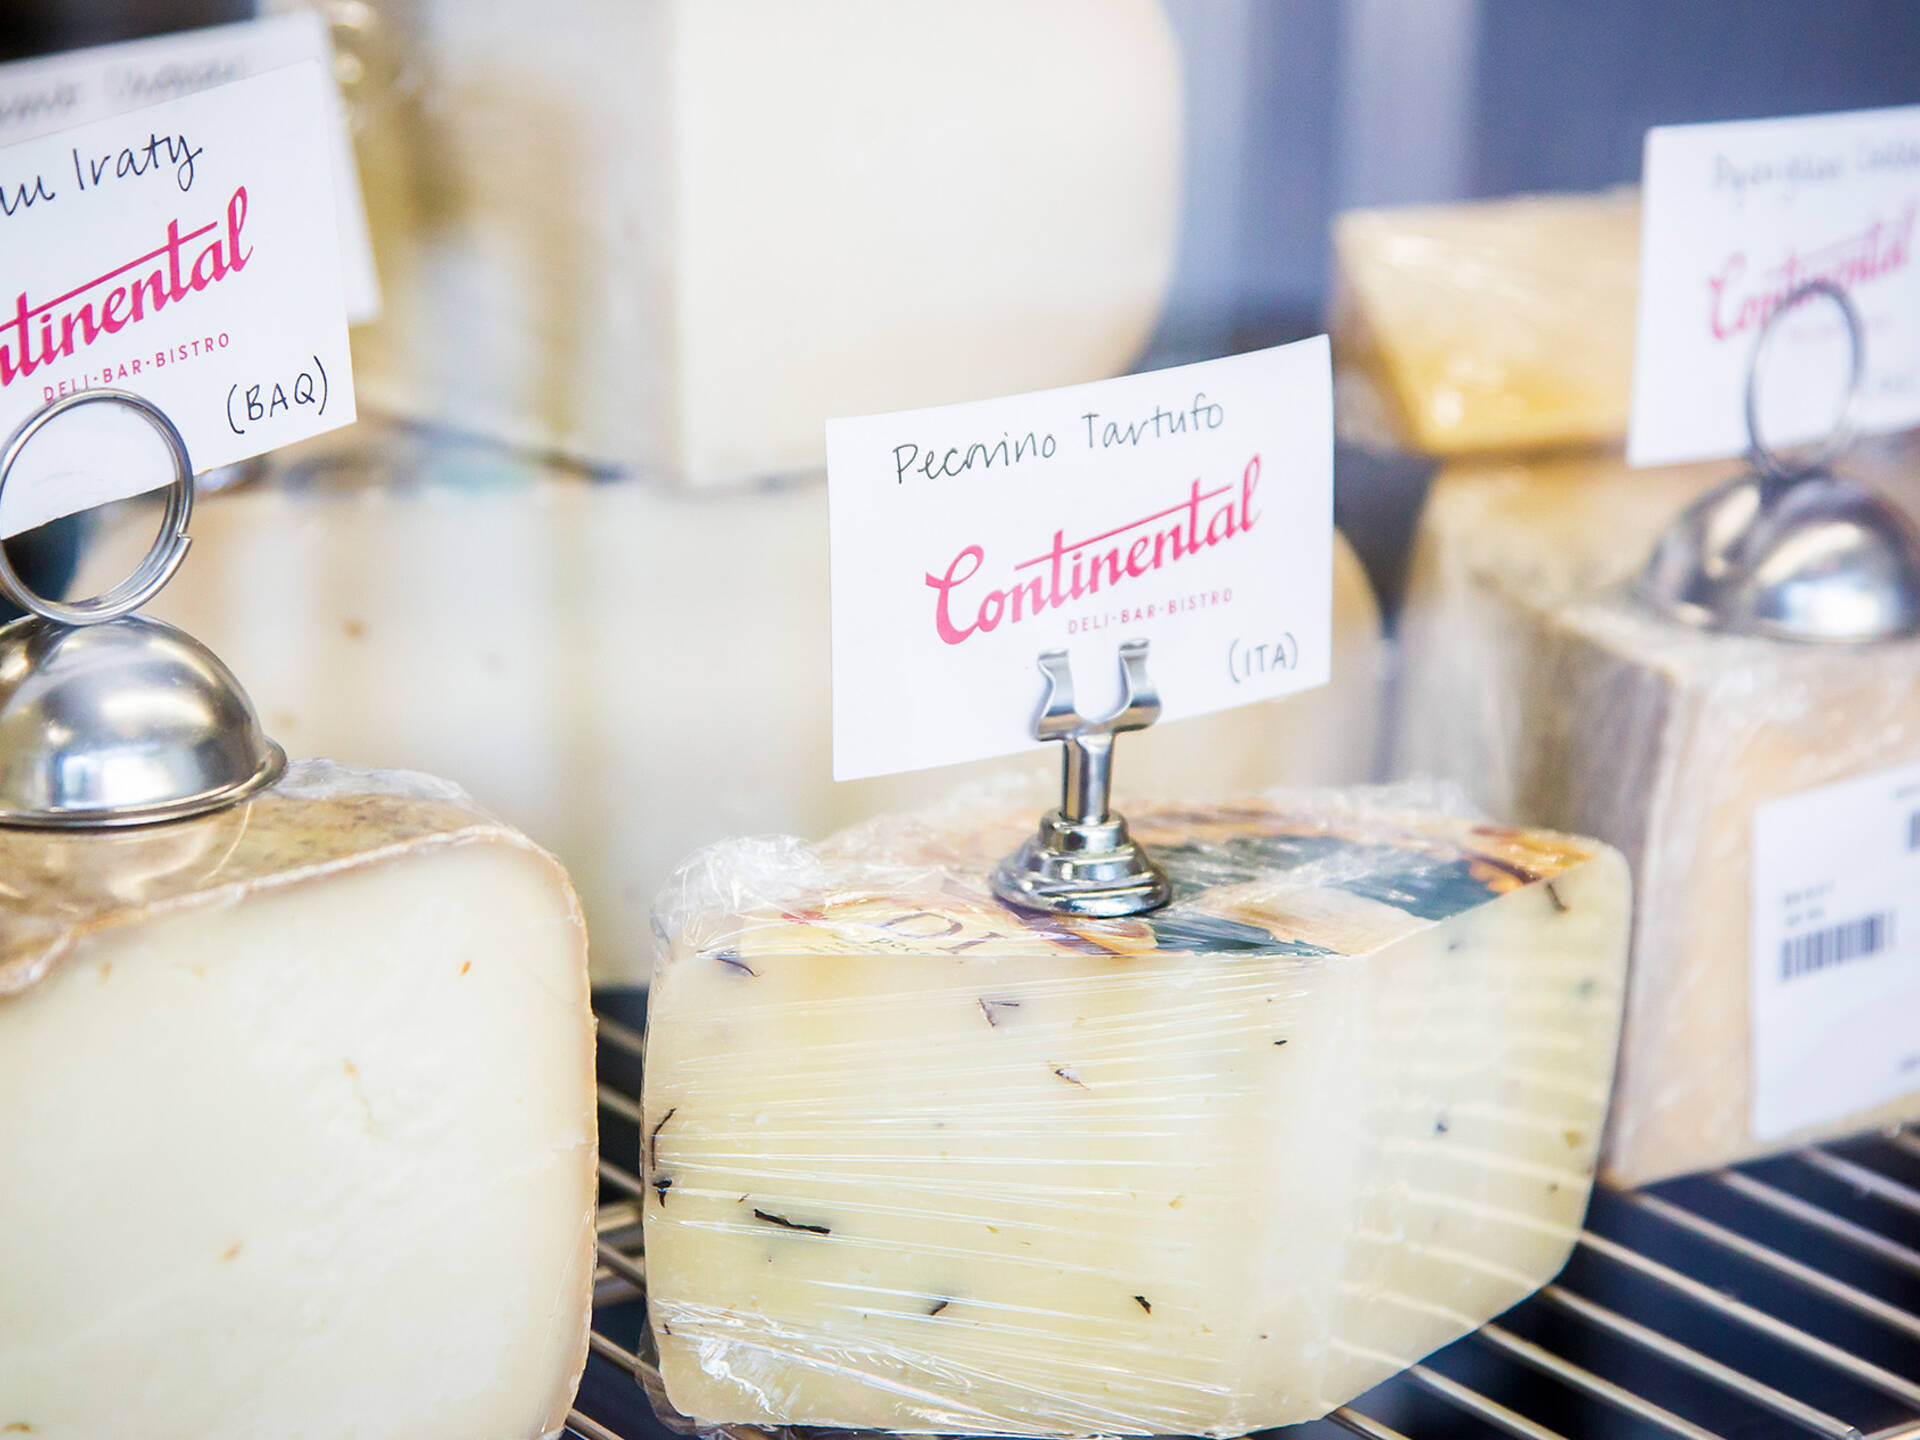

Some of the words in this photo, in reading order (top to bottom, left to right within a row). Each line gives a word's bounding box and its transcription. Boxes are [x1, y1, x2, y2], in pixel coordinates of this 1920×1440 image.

[73, 133, 203, 192] Iraty
[227, 355, 328, 435] (BAQ)
[1082, 392, 1225, 449] Tartufo
[925, 453, 1262, 645] Continental
[1229, 632, 1298, 684] (ITA)
